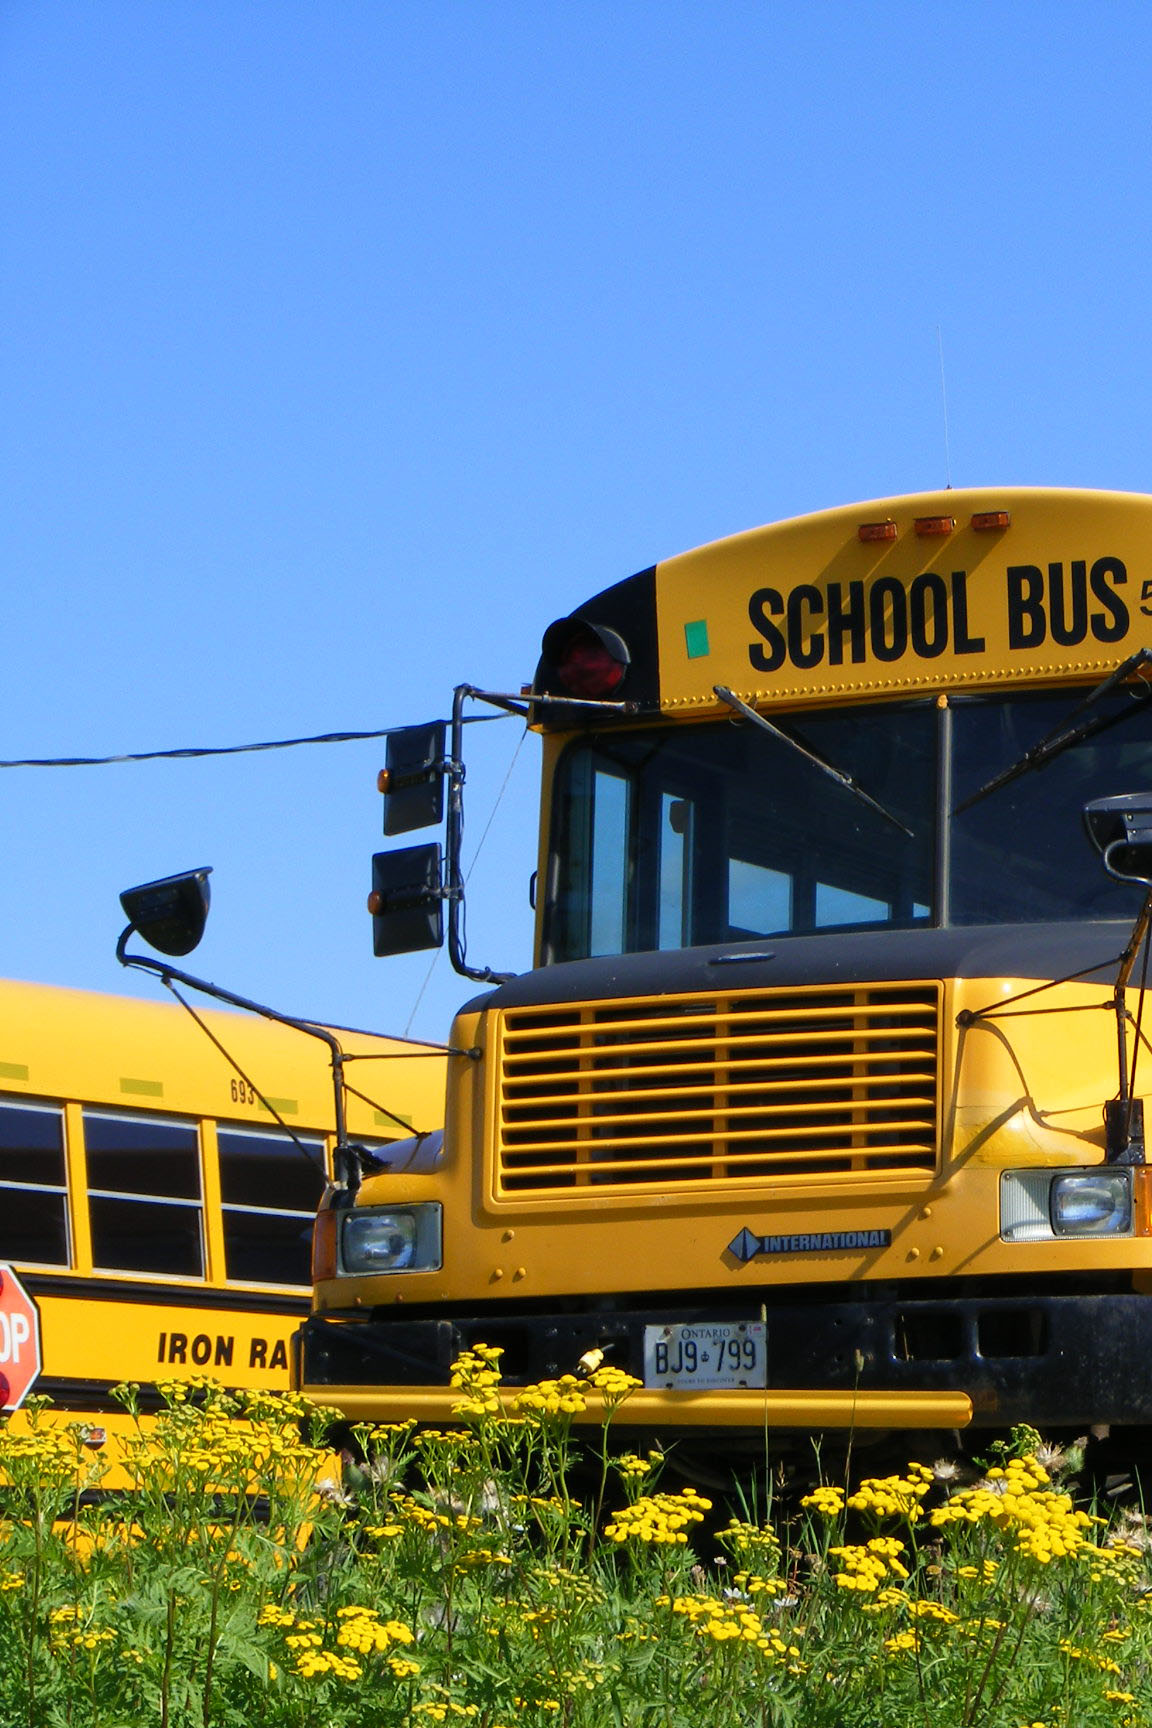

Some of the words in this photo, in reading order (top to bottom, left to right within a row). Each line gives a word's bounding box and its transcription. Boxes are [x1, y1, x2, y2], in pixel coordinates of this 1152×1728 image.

[748, 571, 985, 672] SCHOOL
[1006, 556, 1130, 650] BUS
[231, 1078, 255, 1106] 693
[764, 1230, 888, 1253] INTERNATIONAL
[157, 1332, 234, 1367] IRON
[681, 1328, 731, 1340] ONTARIO
[656, 1341, 698, 1374] BJ9
[712, 1339, 756, 1372] 799
